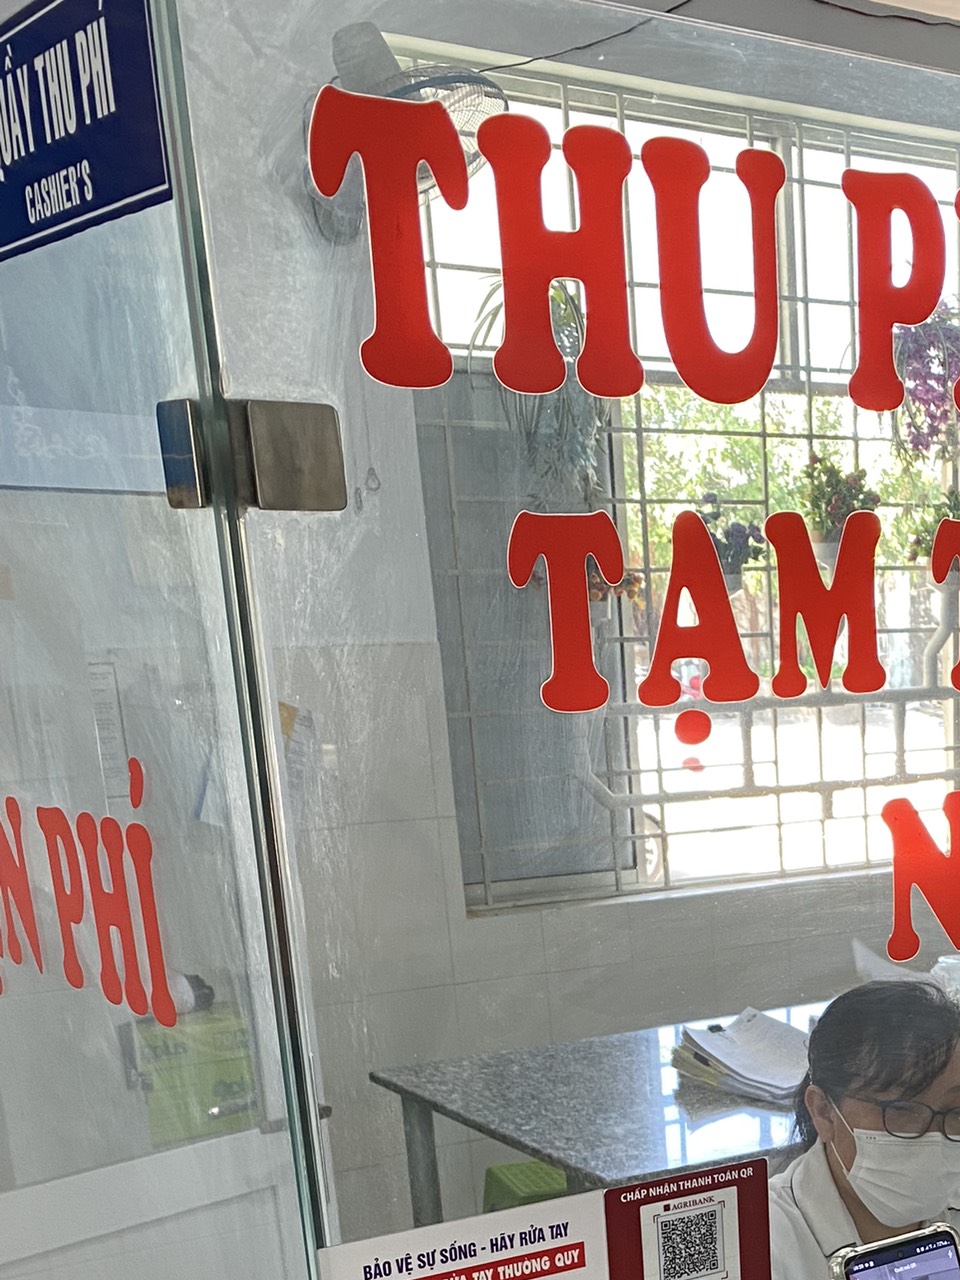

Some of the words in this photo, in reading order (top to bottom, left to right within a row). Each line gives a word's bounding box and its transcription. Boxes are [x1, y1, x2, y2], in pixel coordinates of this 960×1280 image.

[34, 39, 77, 144] THU
[75, 0, 116, 125] PHÍ
[25, 159, 93, 224] CASHIER'S
[309, 85, 787, 404] THU
[507, 511, 887, 745] TẠM
[36, 756, 177, 1028] PHÍ
[621, 1184, 647, 1202] CHẤP
[650, 1180, 677, 1197] NHẬN
[679, 1175, 711, 1191] THANH
[714, 1169, 739, 1184] TOÁN
[741, 1167, 753, 1178] QR
[672, 1196, 715, 1211] AGRIBANK
[363, 1258, 392, 1280] BẢO
[396, 1253, 414, 1275] VỆ
[418, 1249, 437, 1270] SỰ
[440, 1240, 477, 1262] SỐNG
[490, 1234, 515, 1253] HÃY
[519, 1224, 545, 1247] RỬA
[548, 1222, 569, 1240] TAY
[554, 1249, 580, 1267] QUY
